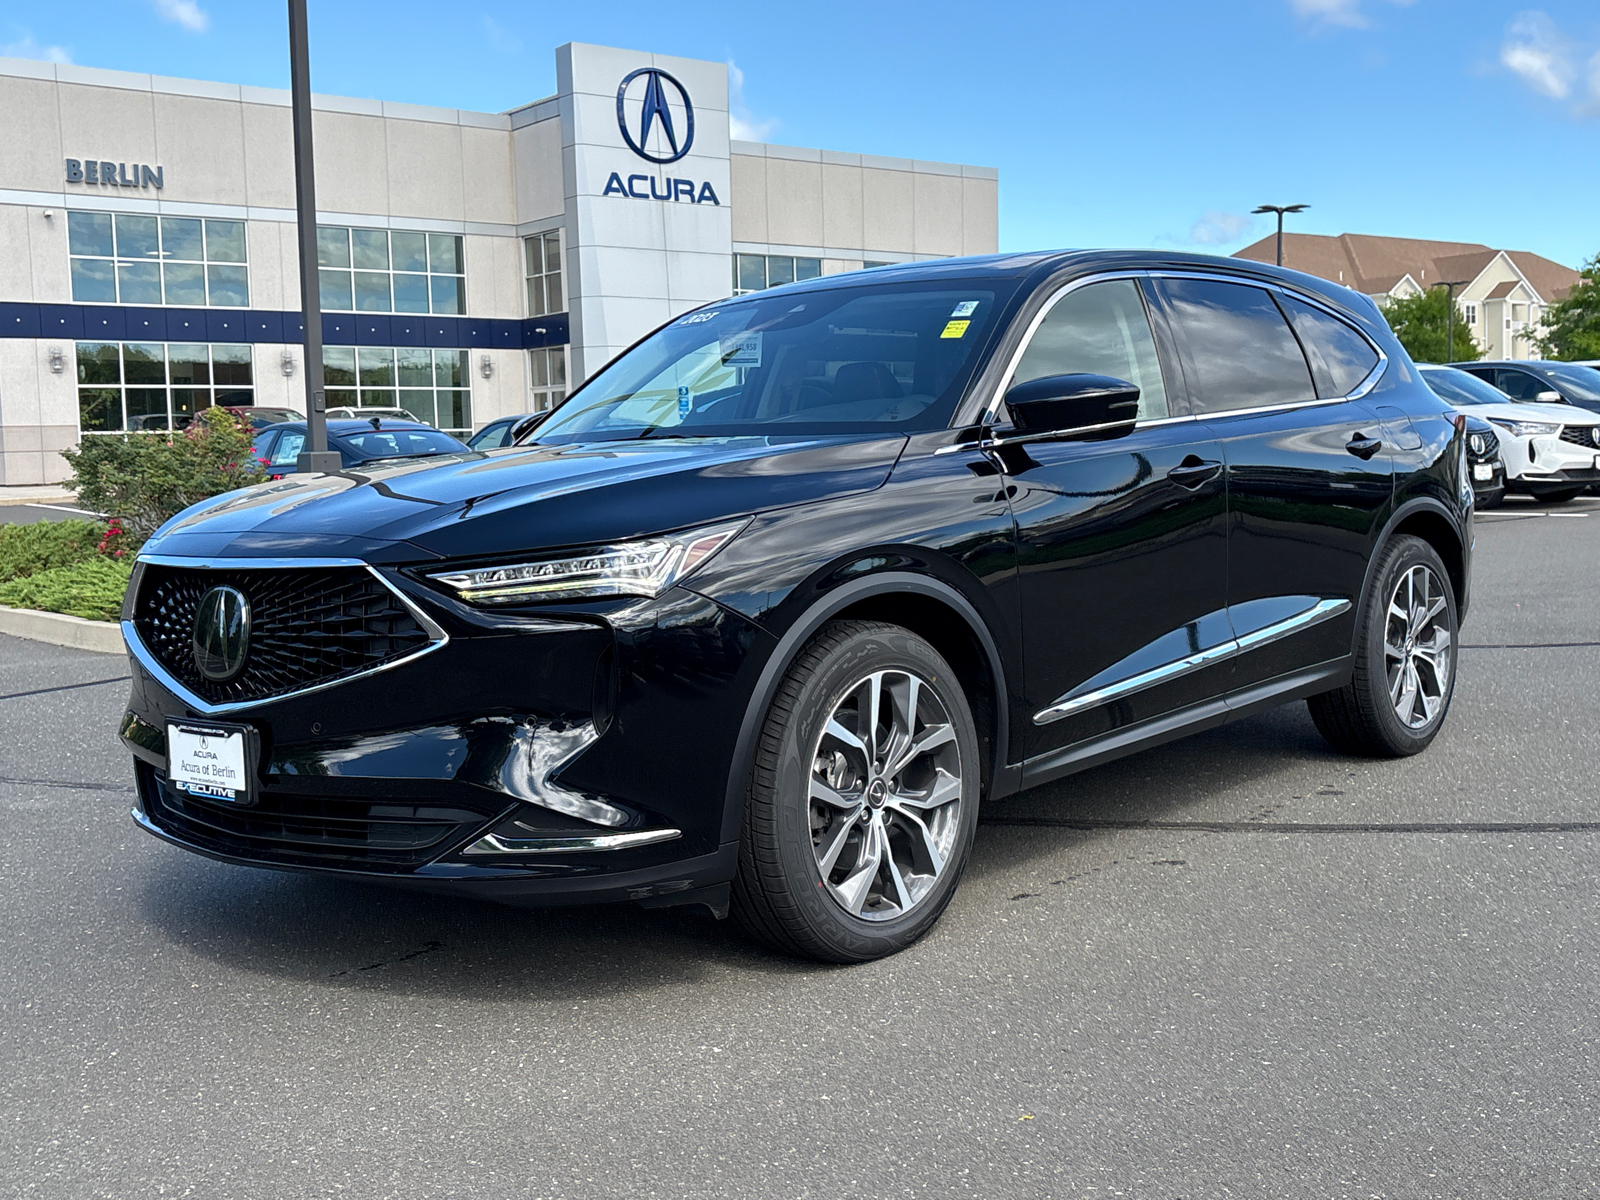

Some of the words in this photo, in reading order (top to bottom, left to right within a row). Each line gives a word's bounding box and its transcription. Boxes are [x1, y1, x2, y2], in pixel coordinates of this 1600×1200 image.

[65, 158, 163, 189] BERLIN
[602, 172, 720, 205] ACURA
[193, 750, 218, 760] ACURA
[181, 760, 200, 774] Acura
[202, 764, 210, 775] of
[211, 764, 236, 779] Berlin
[176, 781, 235, 798] EXECUTIVE
